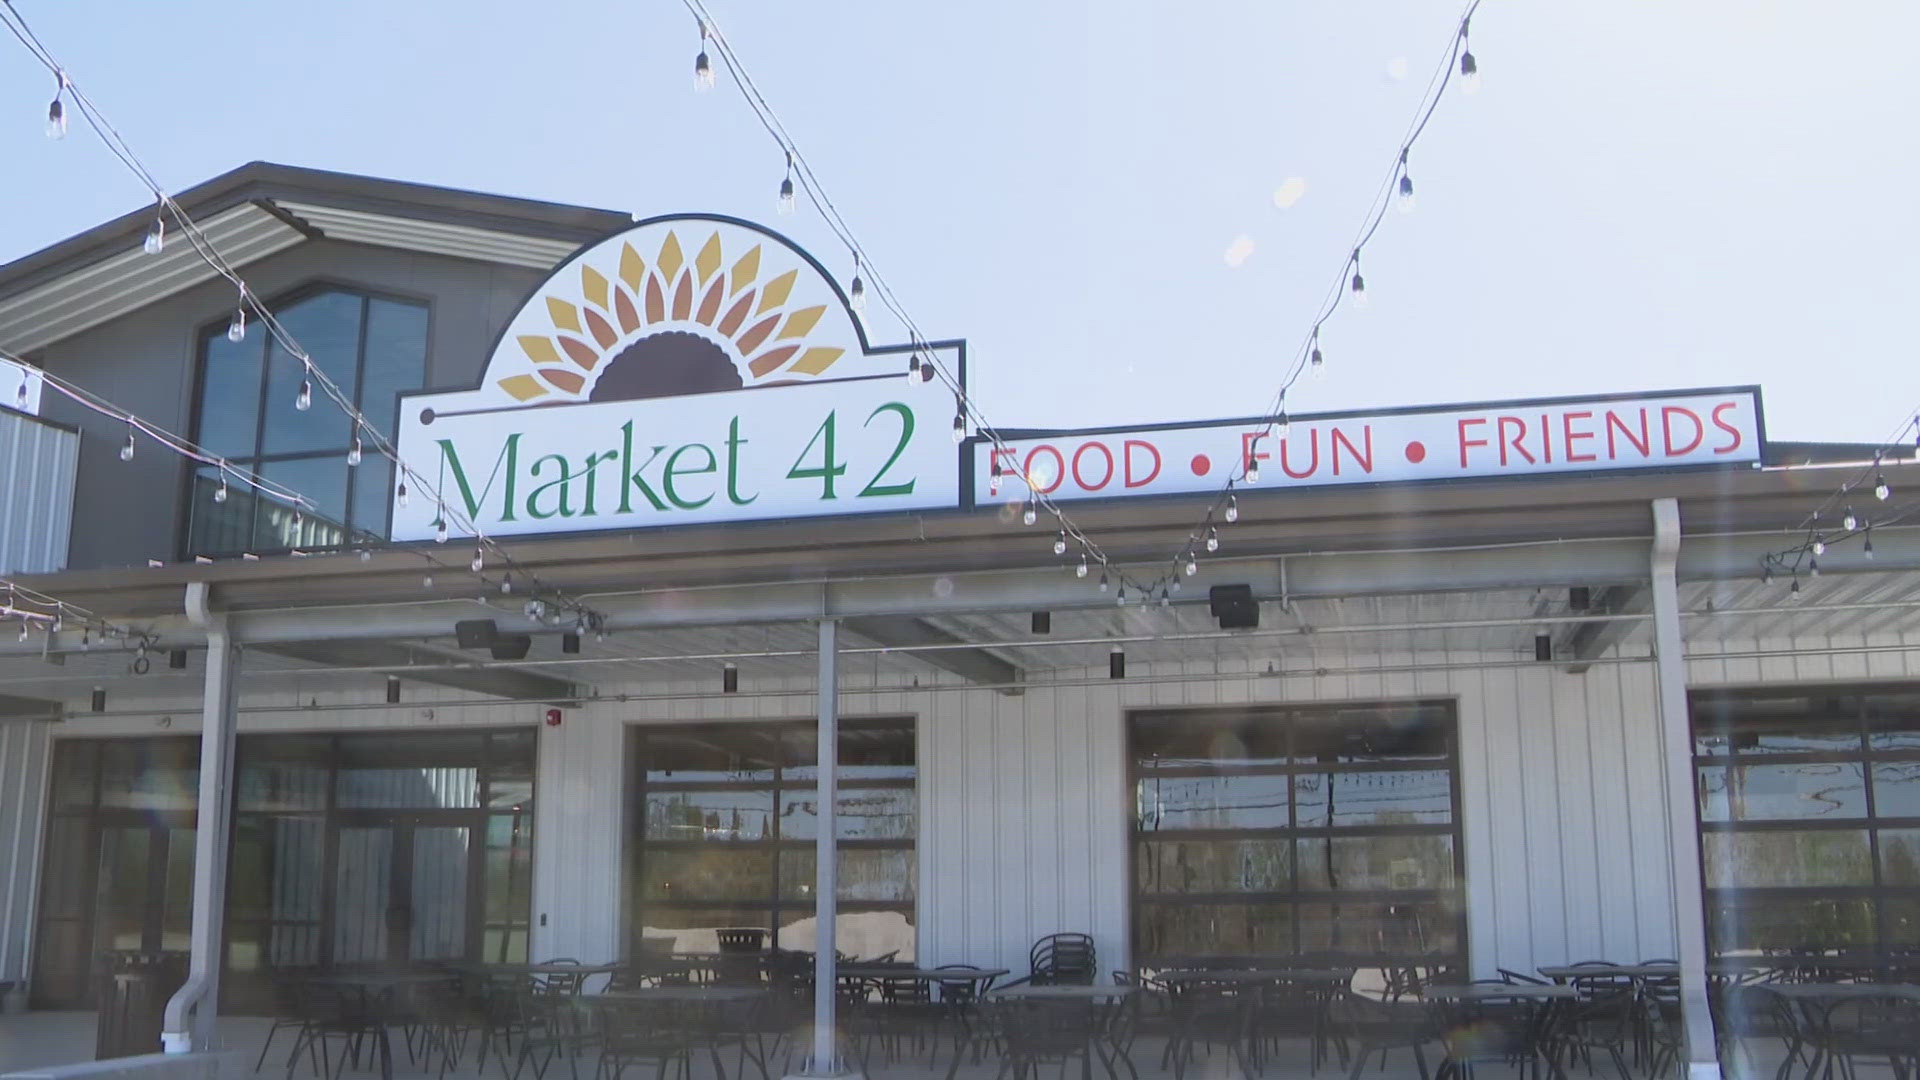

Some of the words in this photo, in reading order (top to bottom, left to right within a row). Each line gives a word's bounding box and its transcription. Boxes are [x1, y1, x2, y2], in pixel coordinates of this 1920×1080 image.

[432, 415, 760, 526] Market
[786, 402, 916, 499] 42
[990, 439, 1162, 496] FOOD
[1243, 425, 1373, 480] FUN
[1458, 403, 1742, 468] FRIENDS
